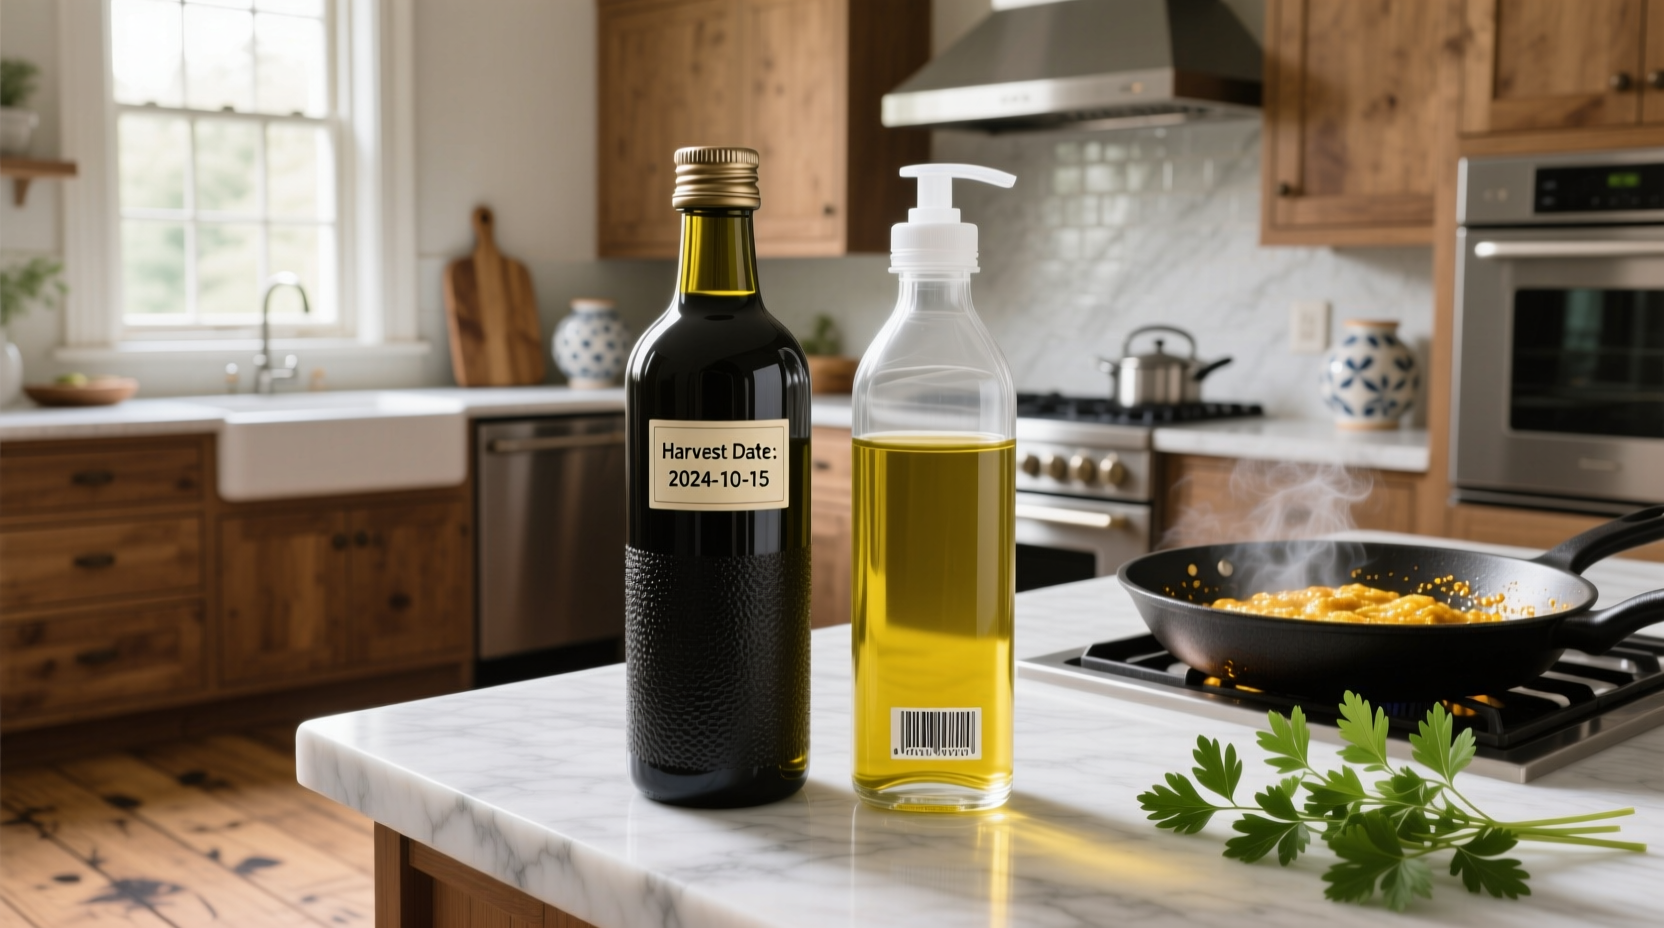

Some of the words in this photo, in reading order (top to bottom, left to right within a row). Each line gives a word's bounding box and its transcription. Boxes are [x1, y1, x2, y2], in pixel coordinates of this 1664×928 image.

[662, 442, 728, 460] Harvest
[732, 443, 777, 460] Date:
[668, 470, 770, 488] 2024-10-15
